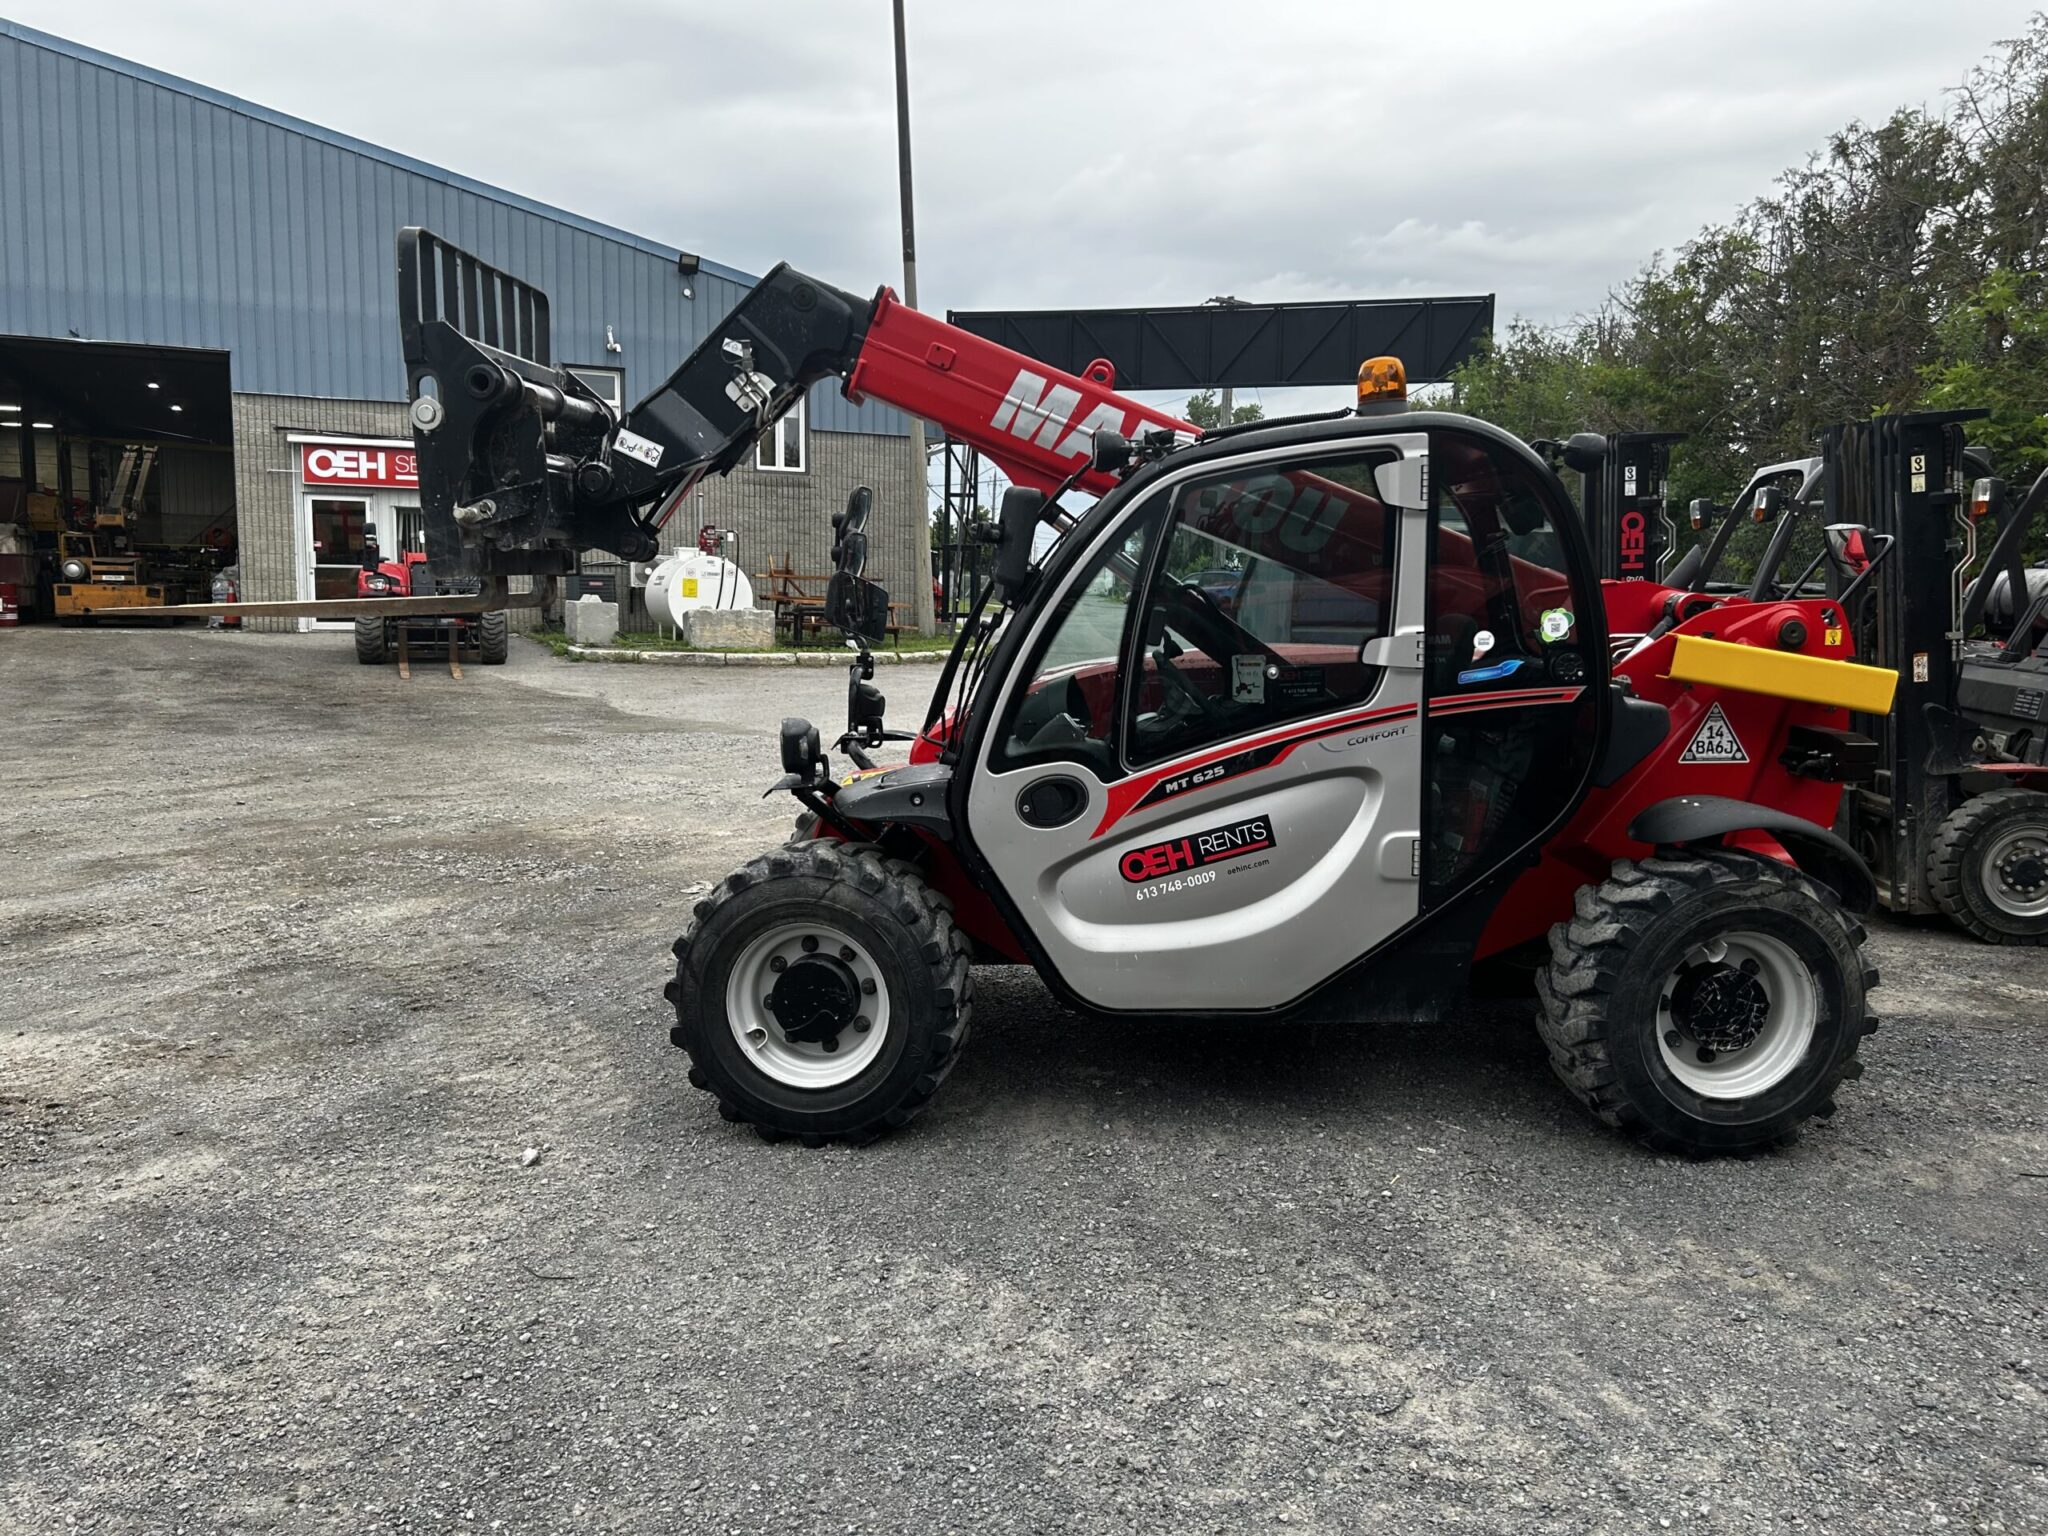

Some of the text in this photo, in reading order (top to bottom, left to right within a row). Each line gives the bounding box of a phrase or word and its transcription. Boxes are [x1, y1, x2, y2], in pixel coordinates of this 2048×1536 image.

[308, 449, 386, 479] OEH
[1621, 511, 1645, 569] OEH
[1347, 726, 1408, 746] COMFORT
[1706, 725, 1724, 739] 14
[1695, 740, 1734, 754] BA6J
[1165, 765, 1225, 794] MT 625
[1122, 822, 1267, 881] OEH RENTS
[1226, 858, 1270, 875] oehinc.com
[1136, 870, 1217, 901] 613 748-0009
